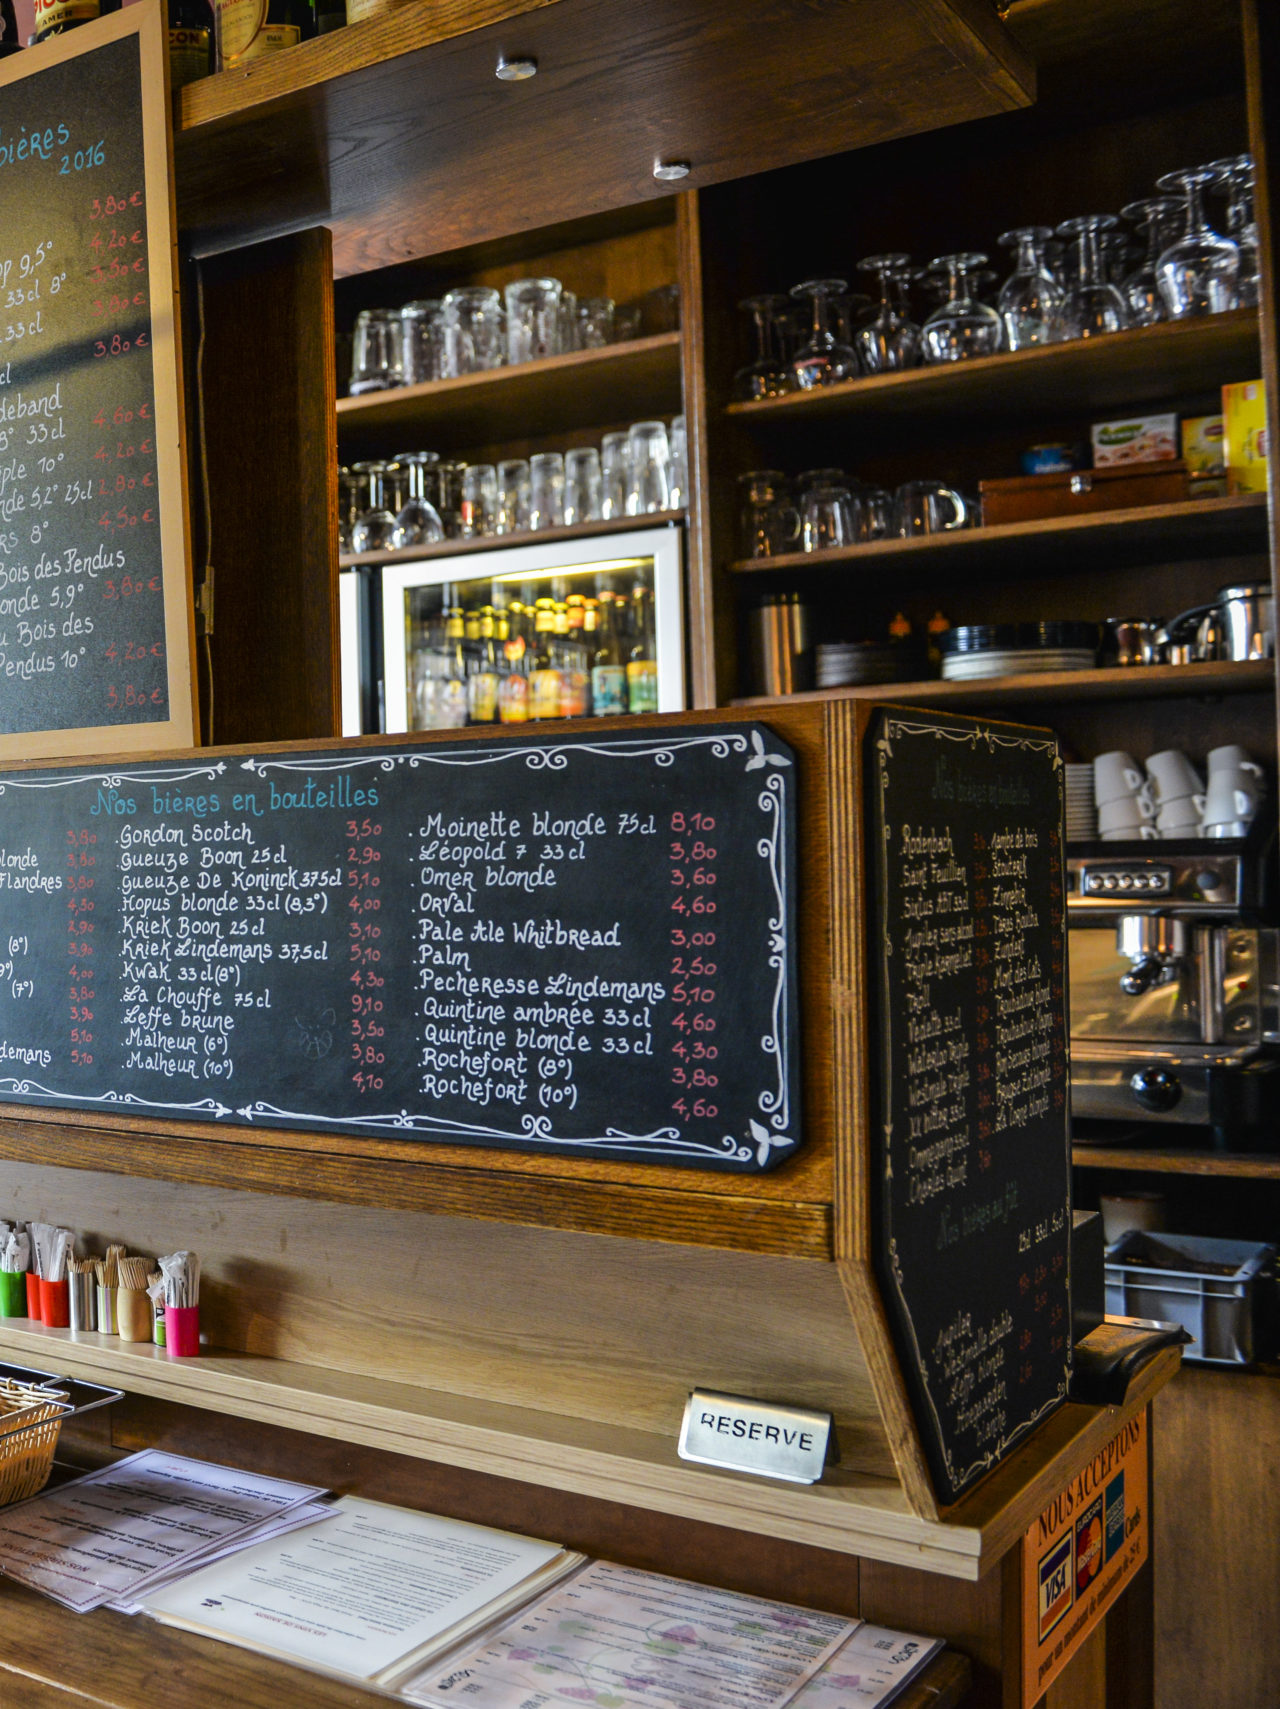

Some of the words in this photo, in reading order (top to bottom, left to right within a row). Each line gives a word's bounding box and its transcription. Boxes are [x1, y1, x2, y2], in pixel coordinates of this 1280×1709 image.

[41, 8, 74, 26] AMER
[59, 140, 105, 175] 2016
[35, 552, 62, 580] des
[64, 544, 125, 579] Pendus
[17, 620, 56, 647] Bois
[62, 612, 94, 636] des
[90, 788, 137, 816] Nos
[151, 786, 220, 818] bières
[232, 794, 264, 817] en
[270, 775, 379, 810] bouteilles
[121, 823, 187, 849] Gordon
[191, 821, 255, 844] Scotch
[345, 819, 382, 841] 3,50
[420, 811, 520, 842] Moinette
[532, 810, 606, 841] blonde
[671, 811, 715, 836] 8,10
[200, 847, 246, 869] Boon
[347, 847, 381, 865] 2,90
[419, 839, 506, 868] Léopold
[516, 845, 526, 860] 7
[670, 842, 716, 864] 3,80
[197, 872, 222, 889] De
[231, 866, 296, 891] Koninck
[421, 867, 477, 892] Omer
[485, 863, 556, 893] blonde
[670, 868, 716, 889] 3,60
[122, 893, 170, 918] Hopus
[181, 891, 238, 916] blonde
[348, 895, 381, 914] 4,00
[420, 892, 475, 917] Orval
[671, 896, 716, 917] 4,60
[123, 916, 171, 939] Kriek
[176, 916, 224, 938] Boon
[419, 918, 463, 942] Pale
[470, 921, 504, 943] Ale
[513, 919, 621, 950] Whitbread
[671, 929, 716, 949] 3,00
[122, 939, 171, 961] Kriek
[175, 939, 272, 964] Lindemans
[350, 944, 381, 965] 5,10
[419, 944, 471, 971] Palm
[671, 957, 716, 980] 2,50
[123, 961, 171, 983] Kwak
[420, 968, 540, 999] Pecheresse
[544, 973, 666, 1005] Lindemans
[672, 982, 715, 1006] 5,10
[123, 985, 148, 1002] La
[157, 986, 222, 1013] Chouffe
[351, 994, 383, 1016] 9,10
[424, 997, 506, 1025] Quintine
[513, 1000, 595, 1030] ambrée
[672, 1013, 716, 1035] 4,60
[124, 1005, 171, 1031] Leffe
[181, 1010, 234, 1036] brune
[126, 1027, 198, 1055] Malheur
[352, 1043, 384, 1066] 3,80
[425, 1023, 506, 1051] Quintine
[516, 1028, 591, 1056] blonde
[672, 1042, 718, 1064] 4,30
[126, 1051, 199, 1079] Malheur
[353, 1072, 383, 1093] 4,10
[423, 1047, 528, 1078] Rochefort
[672, 1067, 718, 1089] 3,80
[423, 1073, 528, 1106] Rochefort
[672, 1098, 718, 1121] 4,60
[701, 1412, 814, 1451] RESERVE
[1038, 1483, 1074, 1548] NOUS
[1075, 1420, 1140, 1508] ACCEPTONS
[1045, 1562, 1067, 1609] VISA
